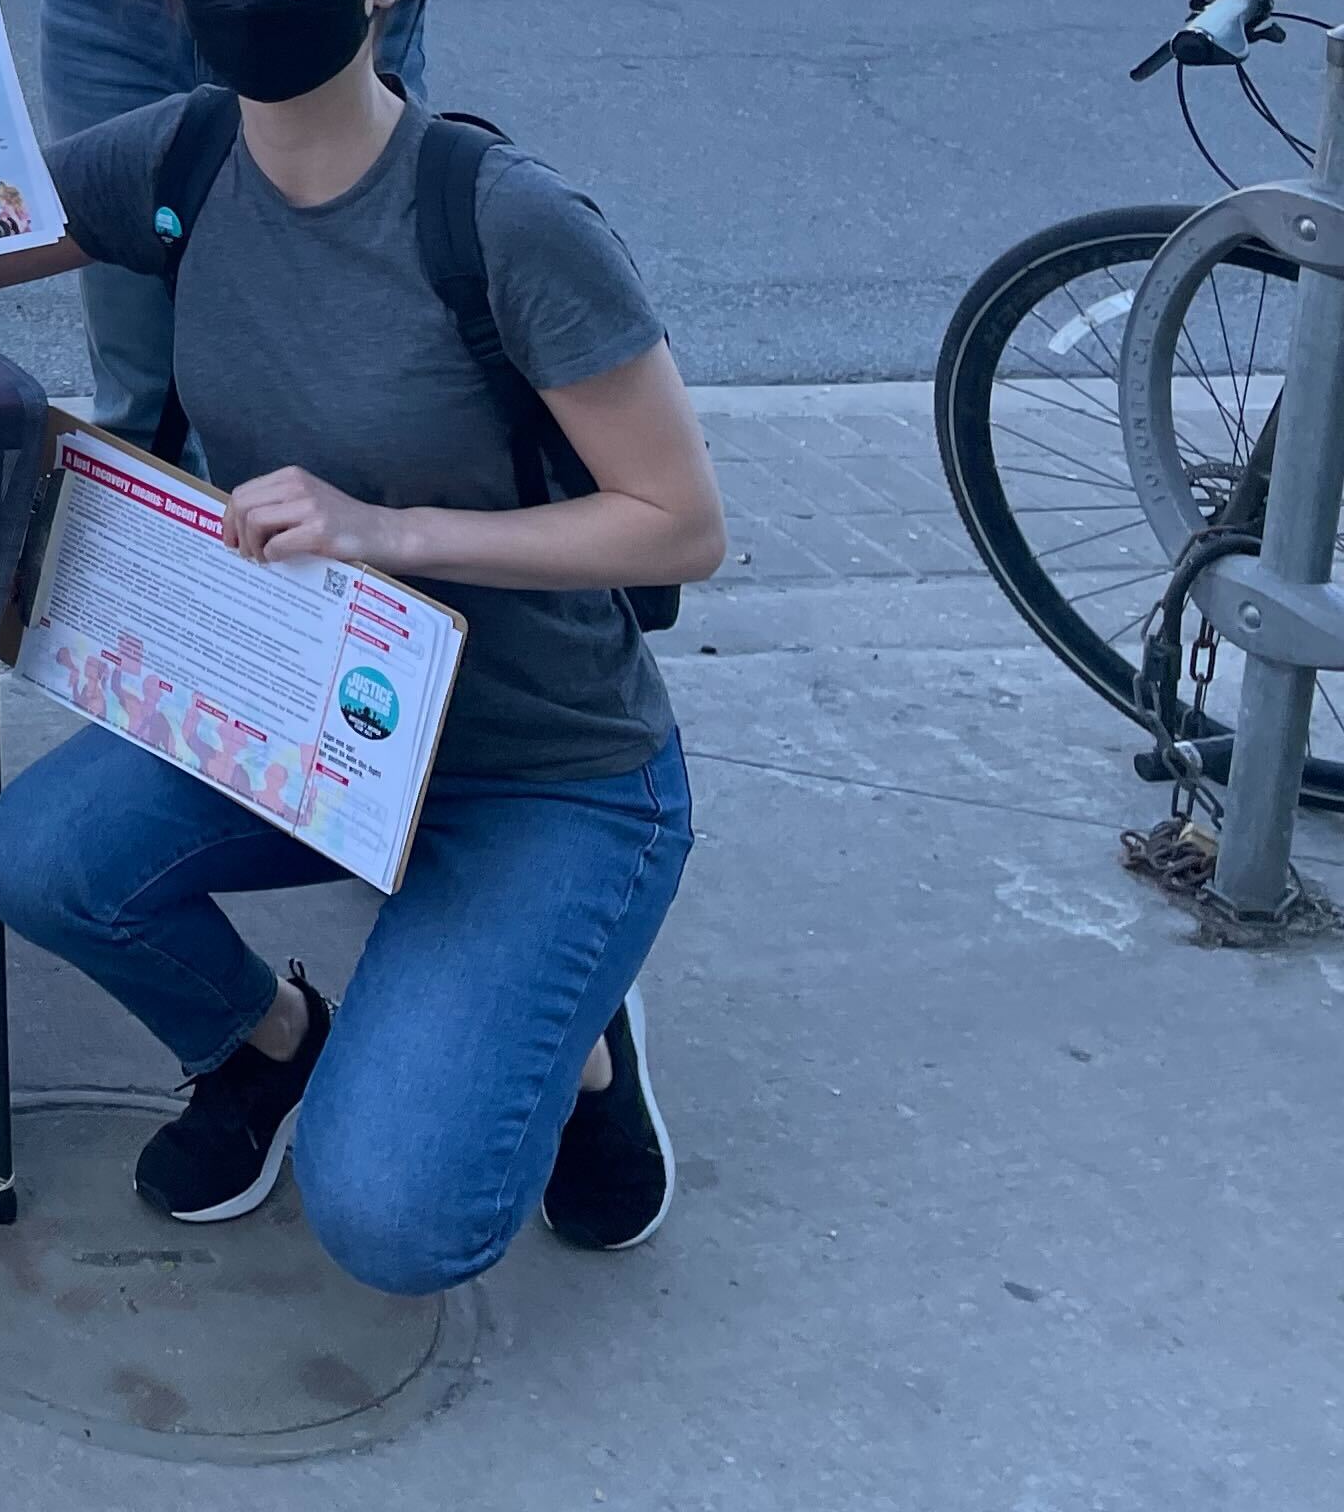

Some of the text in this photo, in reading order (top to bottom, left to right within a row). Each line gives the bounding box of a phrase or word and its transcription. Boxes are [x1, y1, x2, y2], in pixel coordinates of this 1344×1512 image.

[66, 452, 74, 464] A
[73, 457, 91, 472] just
[91, 465, 131, 493] recovery
[164, 497, 198, 524] Decent
[198, 515, 224, 535] work
[347, 671, 394, 706] JUSTICE
